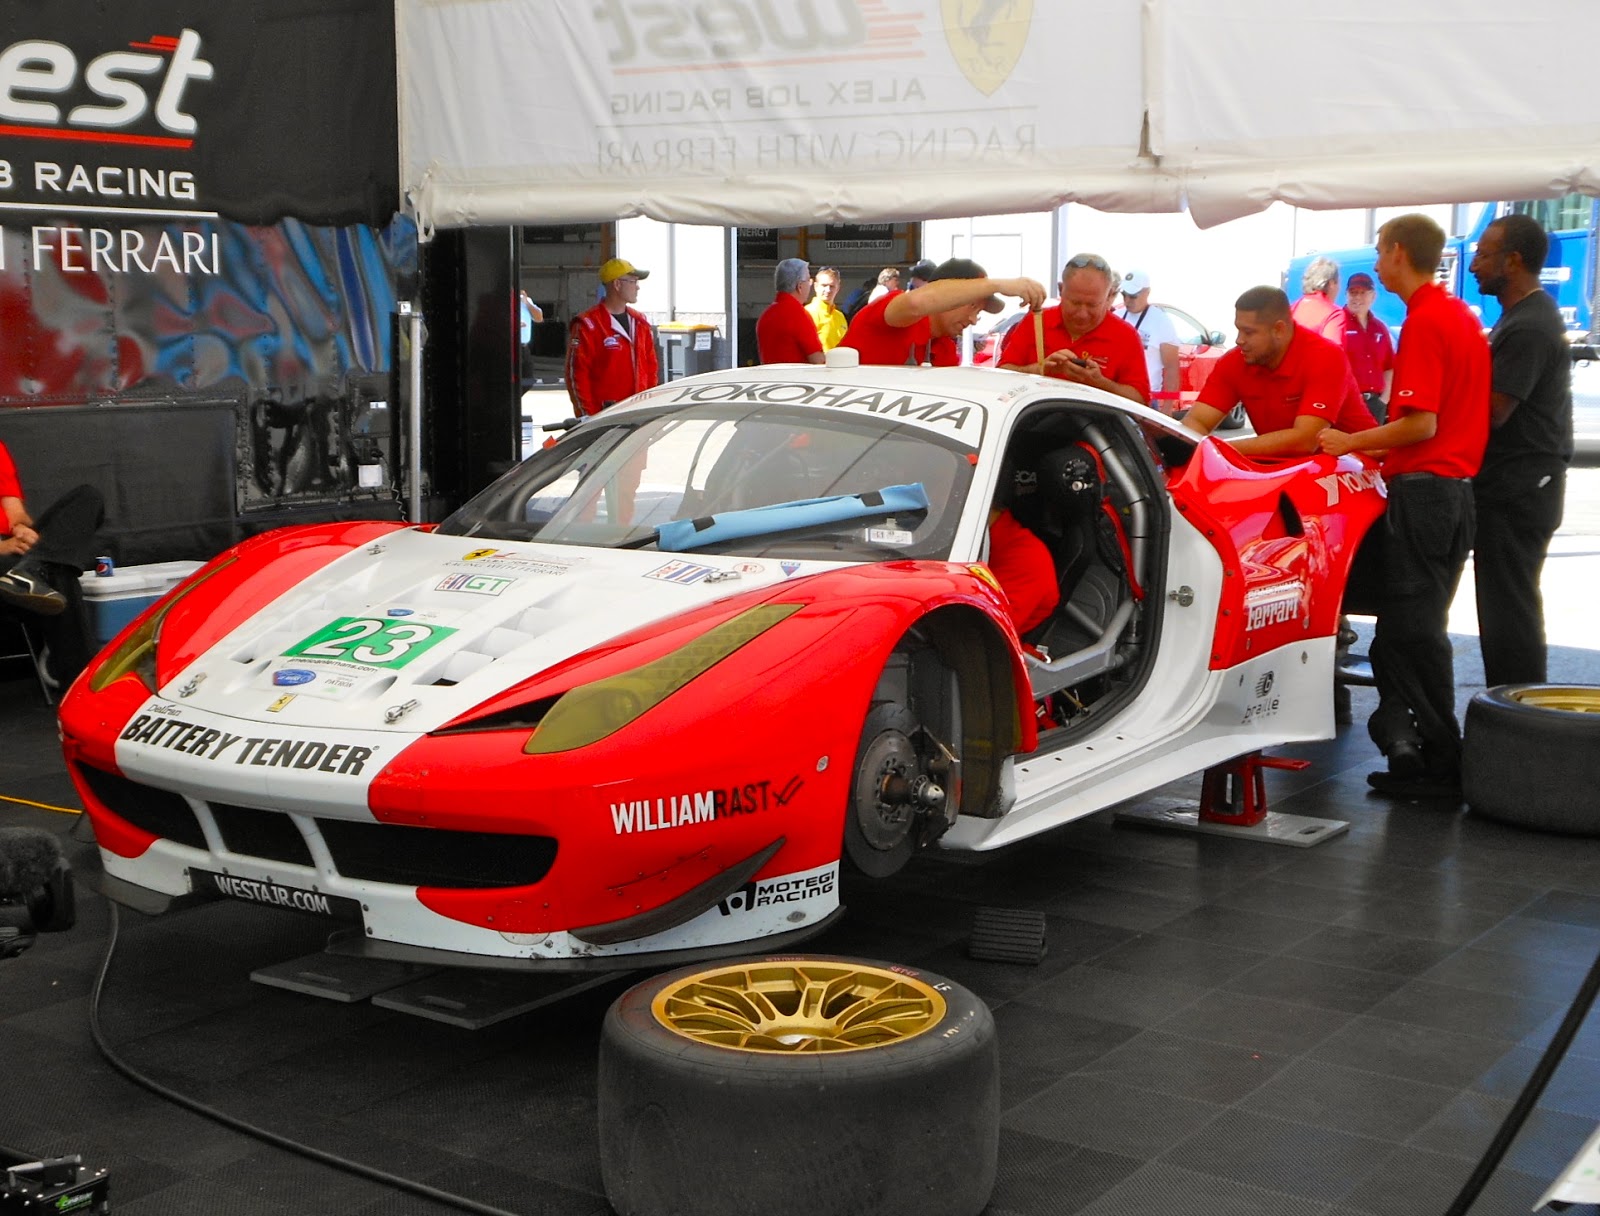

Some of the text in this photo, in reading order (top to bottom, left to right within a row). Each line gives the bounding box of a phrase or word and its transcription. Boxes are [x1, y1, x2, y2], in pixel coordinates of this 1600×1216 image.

[34, 161, 196, 200] RACING
[31, 226, 219, 274] FERRARI
[670, 383, 973, 431] YOKOHAMA
[465, 576, 512, 592] GT
[1245, 598, 1300, 632] Ferrari
[299, 618, 434, 664] 23
[1244, 697, 1279, 719] braille
[119, 714, 373, 776] BATTERY TENDER
[213, 874, 332, 915] WESTAJR.COM
[756, 882, 834, 908] RACING
[757, 870, 836, 896] MOTEGI
